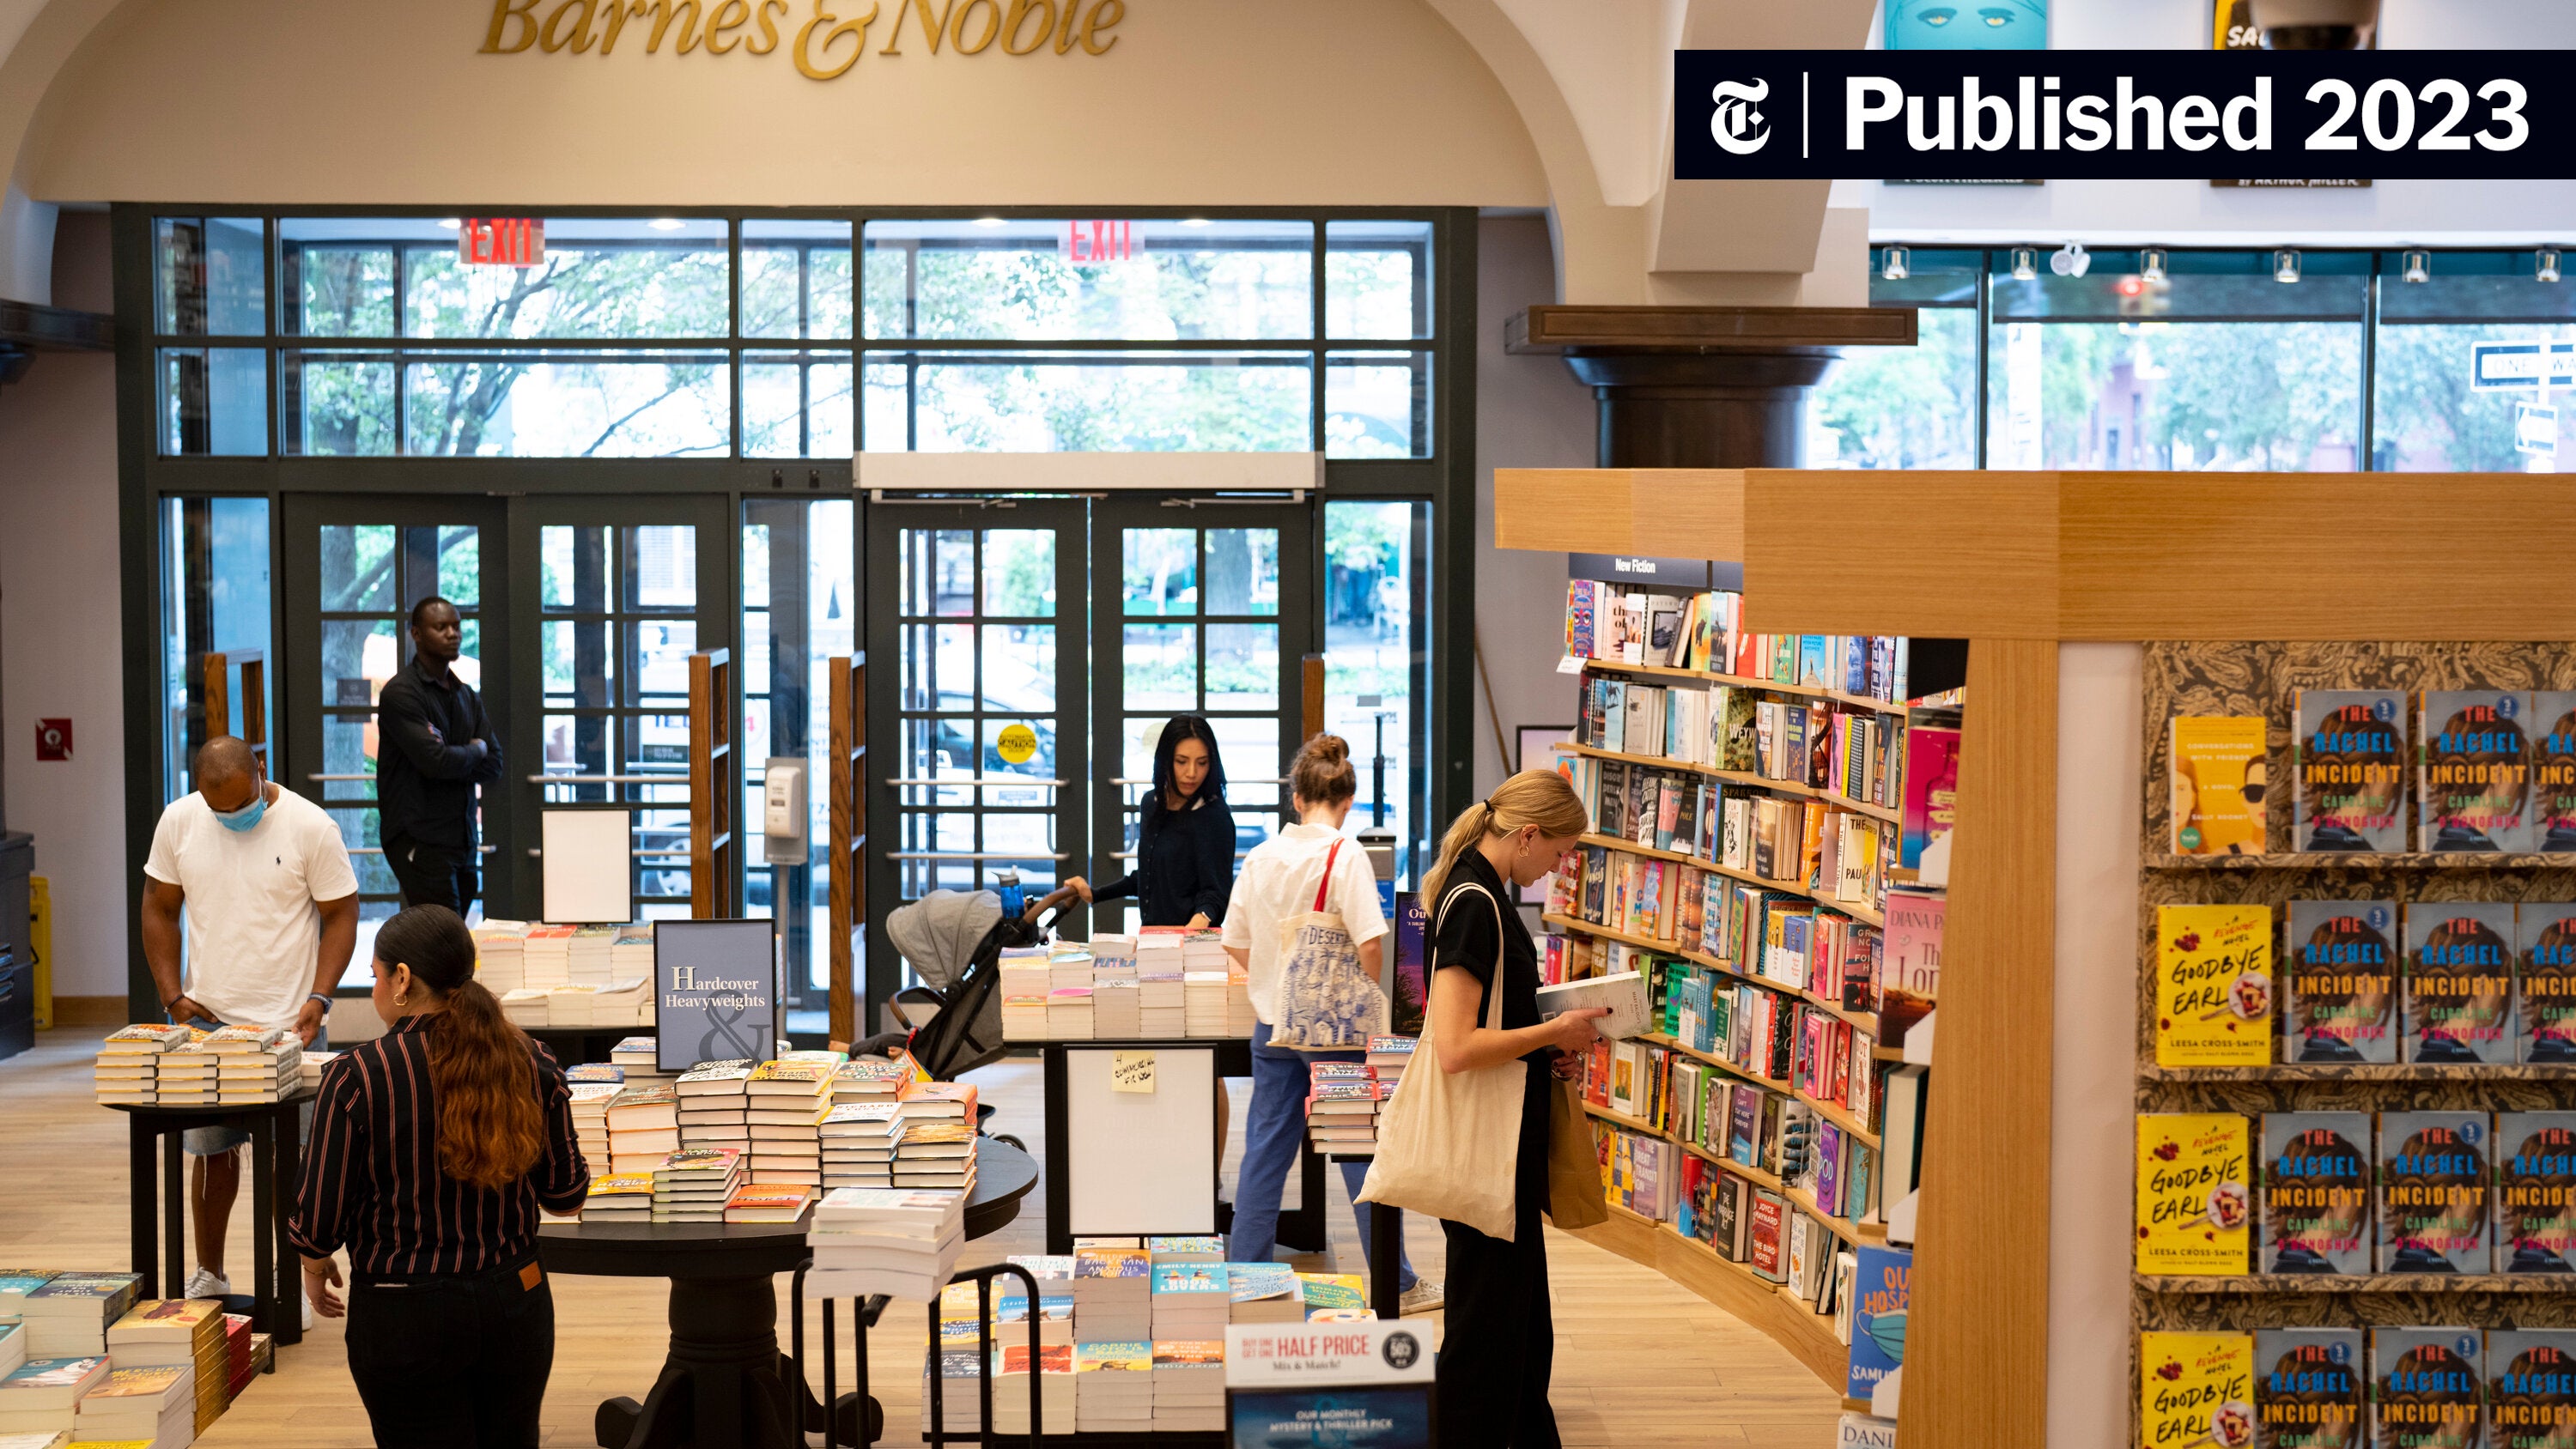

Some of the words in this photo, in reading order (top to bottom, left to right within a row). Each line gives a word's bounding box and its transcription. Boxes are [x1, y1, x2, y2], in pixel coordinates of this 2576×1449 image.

[478, 0, 780, 57] Barnes
[793, 0, 878, 81] &
[878, 0, 1127, 57] Noble
[2494, 358, 2532, 373] ONE
[1615, 558, 1630, 573] New
[1631, 559, 1656, 573] Fiction
[2338, 706, 2371, 722] THE
[2464, 706, 2495, 722] THE
[998, 739, 1036, 749] CAUTION
[2314, 732, 2394, 753] RACHEL
[2439, 732, 2519, 753] RACHEL
[2306, 765, 2401, 784] INCIDENT
[2432, 765, 2526, 784] INCIDENT
[2540, 766, 2575, 785] INC
[1722, 787, 1767, 797] SPARROW
[2323, 796, 2385, 808] CAROLINE
[2449, 796, 2510, 808] CAROLINE
[1850, 819, 1866, 831] THE
[2312, 815, 2395, 828] O'DONOGHUE
[2438, 816, 2520, 828] O'DONOGHUE
[1846, 869, 1862, 880] PAU
[1891, 911, 1930, 929] DIANA
[1934, 914, 1943, 930] P
[2328, 917, 2361, 933] THE
[2445, 918, 2478, 934] THE
[2223, 934, 2250, 946] NOVEL
[1922, 943, 1940, 967] Th
[2305, 944, 2385, 964] RACHEL
[2421, 945, 2502, 965] RACHEL
[2172, 944, 2265, 985] GOODBYE
[671, 967, 759, 992] Hardcover
[2298, 975, 2391, 995] INCIDENT
[2414, 976, 2509, 996] INCIDENT
[665, 994, 766, 1011] Heavyweights
[2173, 986, 2228, 1015] EARL
[2313, 1005, 2375, 1019] CAROLINE
[2430, 1007, 2493, 1020] CAROLINE
[2305, 1026, 2385, 1039] O'DONOGHUE
[2421, 1027, 2503, 1040] O'DONOGHUE
[2303, 1129, 2336, 1145] THE
[2420, 1128, 2453, 1144] THE
[2538, 1128, 2571, 1144] THE
[2202, 1144, 2228, 1156] NOVEL
[2278, 1156, 2359, 1177] RACHEL
[2396, 1155, 2477, 1175] RACHEL
[2150, 1155, 2243, 1194] GOODBYE
[2270, 1188, 2366, 1207] INCIDENT
[2389, 1186, 2484, 1206] INCIDENT
[1759, 1203, 1774, 1215] JOYCE
[2153, 1196, 2208, 1223] EARL
[1753, 1210, 1778, 1226] MAYNARD
[2287, 1218, 2348, 1231] CAROLINE
[2405, 1216, 2468, 1230] CAROLINE
[1753, 1240, 1762, 1251] THE
[1763, 1242, 1776, 1255] BIRD
[2277, 1238, 2360, 1251] O'DONOGHUE
[2396, 1237, 2478, 1250] O'DONOGHUE
[1755, 1251, 1771, 1264] HOTEL
[1242, 1338, 1256, 1347] BUY
[1260, 1337, 1273, 1347] ONE
[1278, 1337, 1318, 1357] HALF
[1323, 1335, 1370, 1355] PRICE
[1242, 1349, 1256, 1358] GET
[1260, 1348, 1273, 1357] ONE
[2295, 1345, 2327, 1361] THE
[2415, 1345, 2447, 1361] THE
[2527, 1346, 2561, 1363] THE
[1273, 1361, 1291, 1371] Mix
[1295, 1361, 1302, 1370] &
[1306, 1359, 1341, 1370] Match!
[2205, 1363, 2231, 1374] NOVEL
[2269, 1371, 2350, 1392] RACHEL
[2391, 1371, 2470, 1391] RACHEL
[2154, 1373, 2246, 1414] GOODBYE
[1295, 1410, 1318, 1421] OUR
[1320, 1409, 1366, 1419] MONTHLY
[2263, 1404, 2358, 1423] INCIDENT
[2383, 1404, 2478, 1423] INCIDENT
[1269, 1422, 1312, 1432] MYSTERY
[1315, 1422, 1321, 1431] &
[1323, 1421, 1369, 1430] THRILLER
[1370, 1418, 1394, 1428] PICK
[2156, 1416, 2211, 1443] EARL
[1844, 1427, 1893, 1448] DANI
[2279, 1434, 2342, 1447] CAROLINE
[2399, 1434, 2462, 1447] CAROLINE
